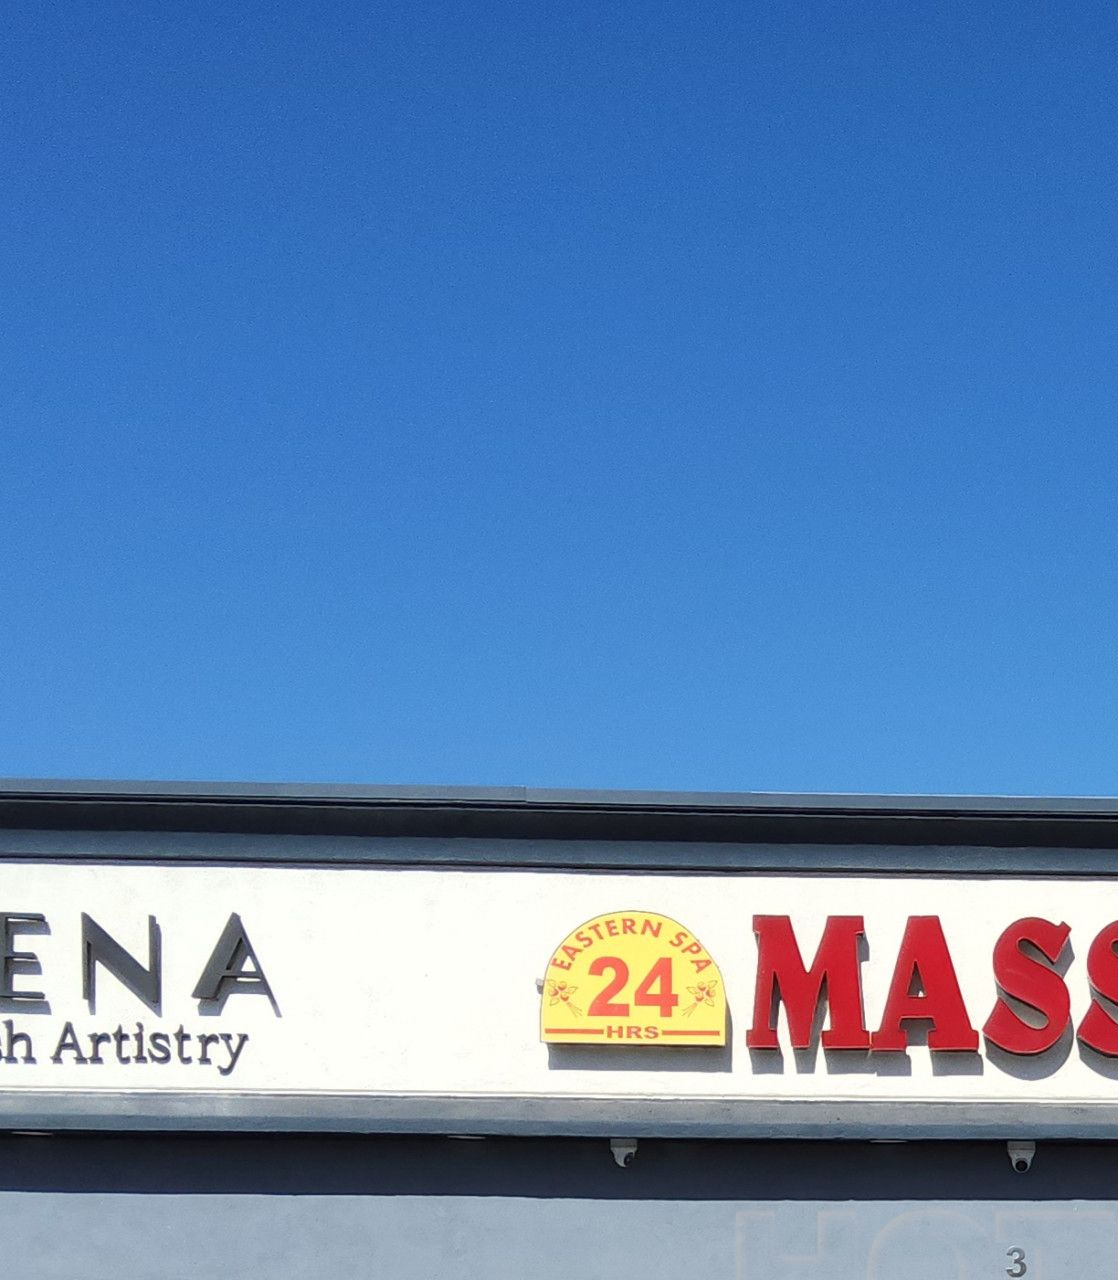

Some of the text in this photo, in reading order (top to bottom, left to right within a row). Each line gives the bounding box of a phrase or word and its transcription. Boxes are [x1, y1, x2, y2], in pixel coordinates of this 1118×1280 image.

[551, 918, 712, 973] EASTERN SPA
[587, 956, 678, 1017] 24
[0, 1019, 249, 1076] h Artistry
[606, 1026, 659, 1039] HRS
[1005, 1246, 1027, 1278] 3
